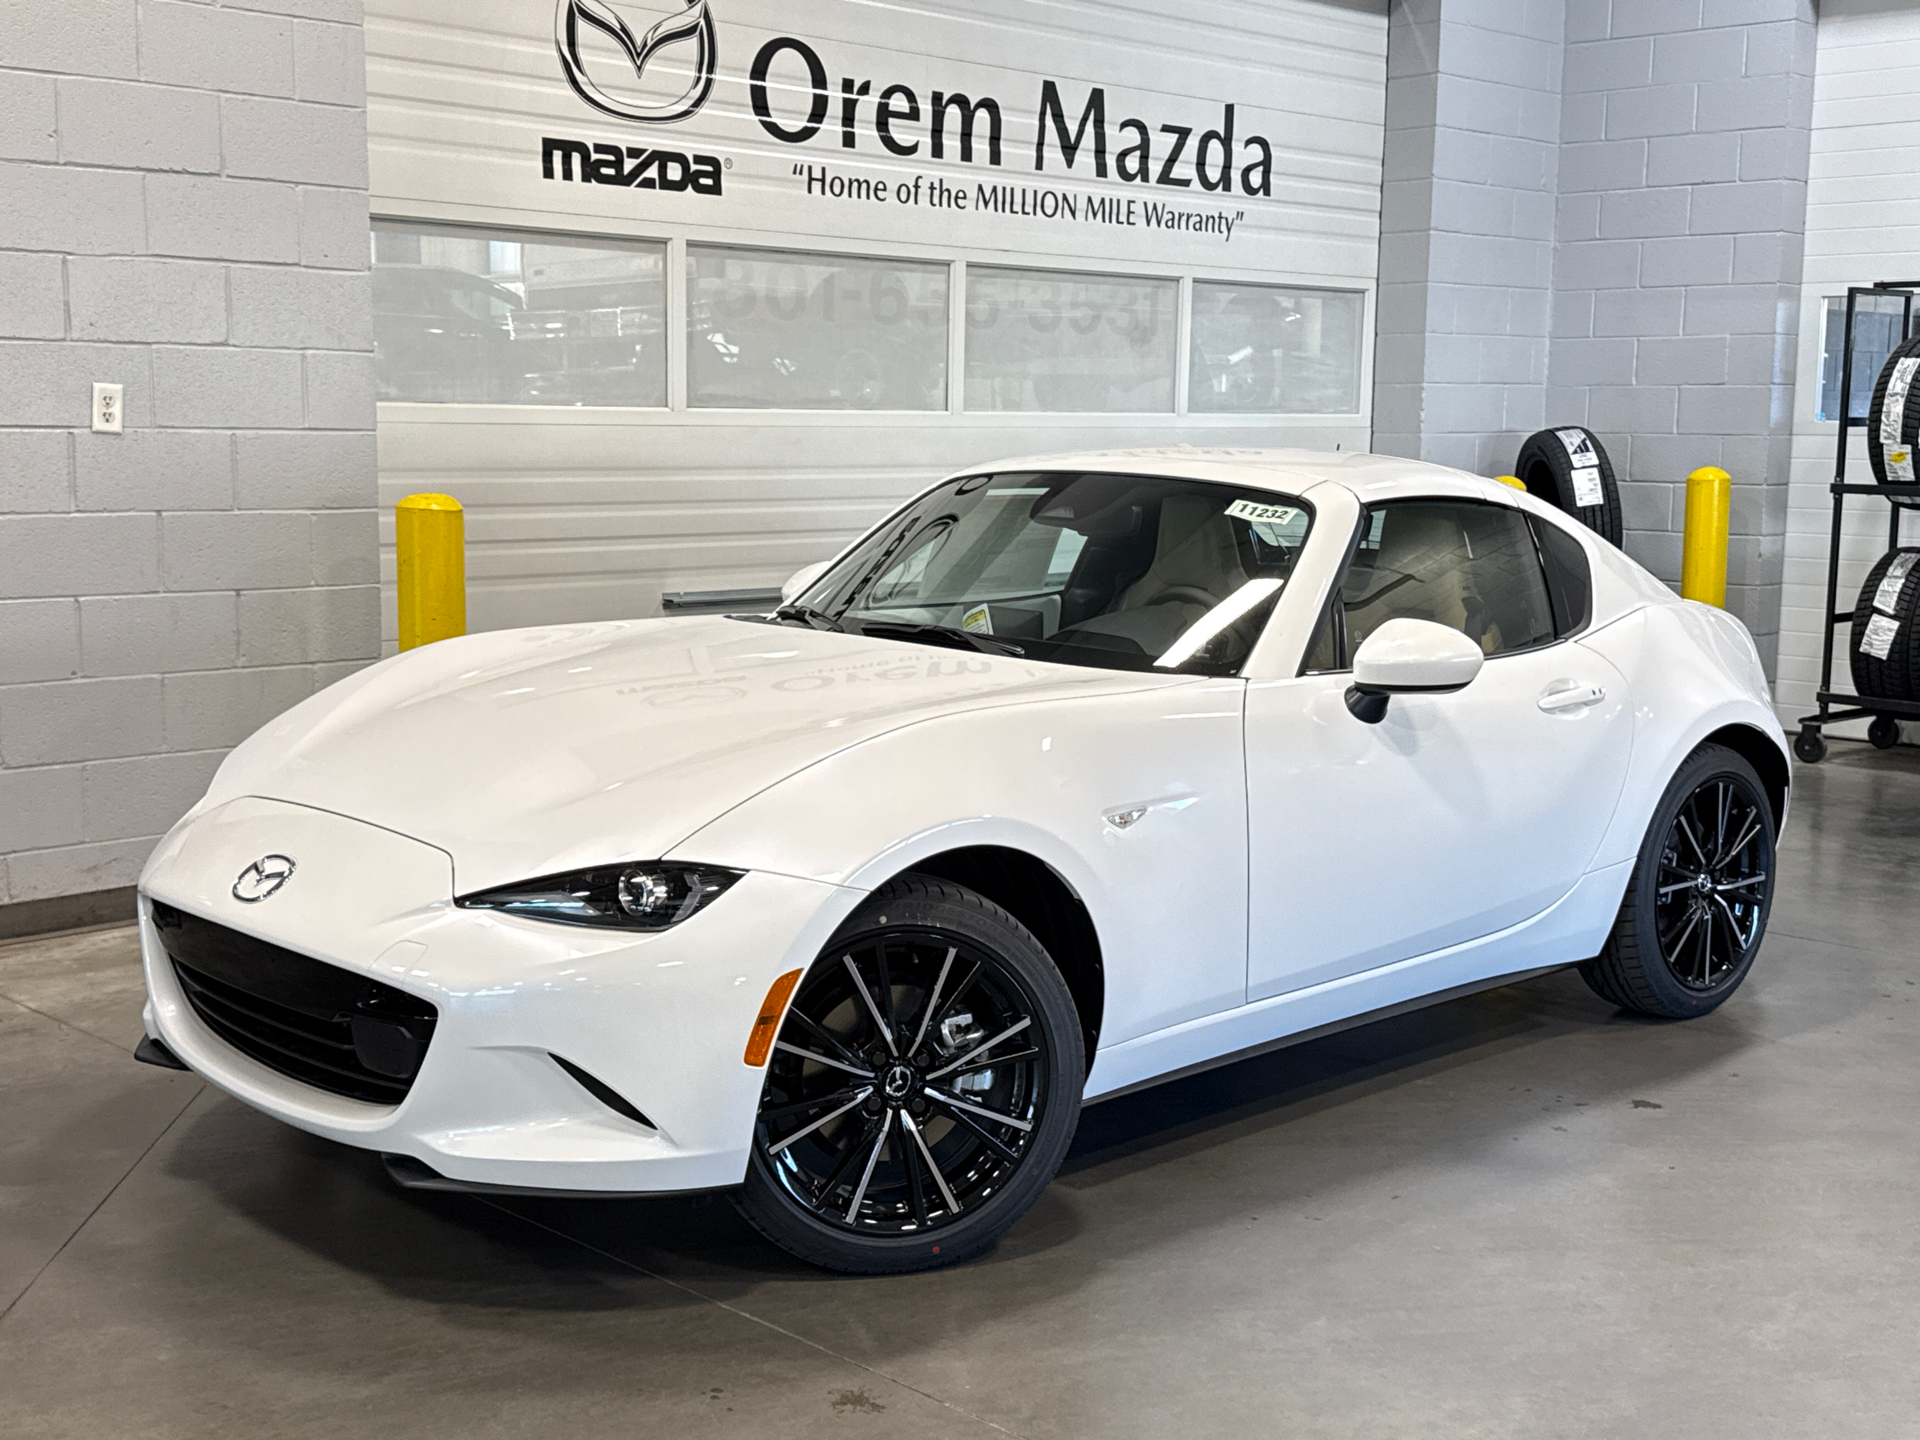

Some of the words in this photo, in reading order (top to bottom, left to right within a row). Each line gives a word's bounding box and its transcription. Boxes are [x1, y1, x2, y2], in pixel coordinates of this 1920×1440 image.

[749, 37, 1002, 166] Orem
[1035, 80, 1272, 197] Mazda
[896, 175, 923, 205] of
[928, 178, 968, 210] the
[975, 183, 1077, 220] MILLION
[1085, 195, 1136, 226] MILE
[1239, 503, 1289, 519] 11232
